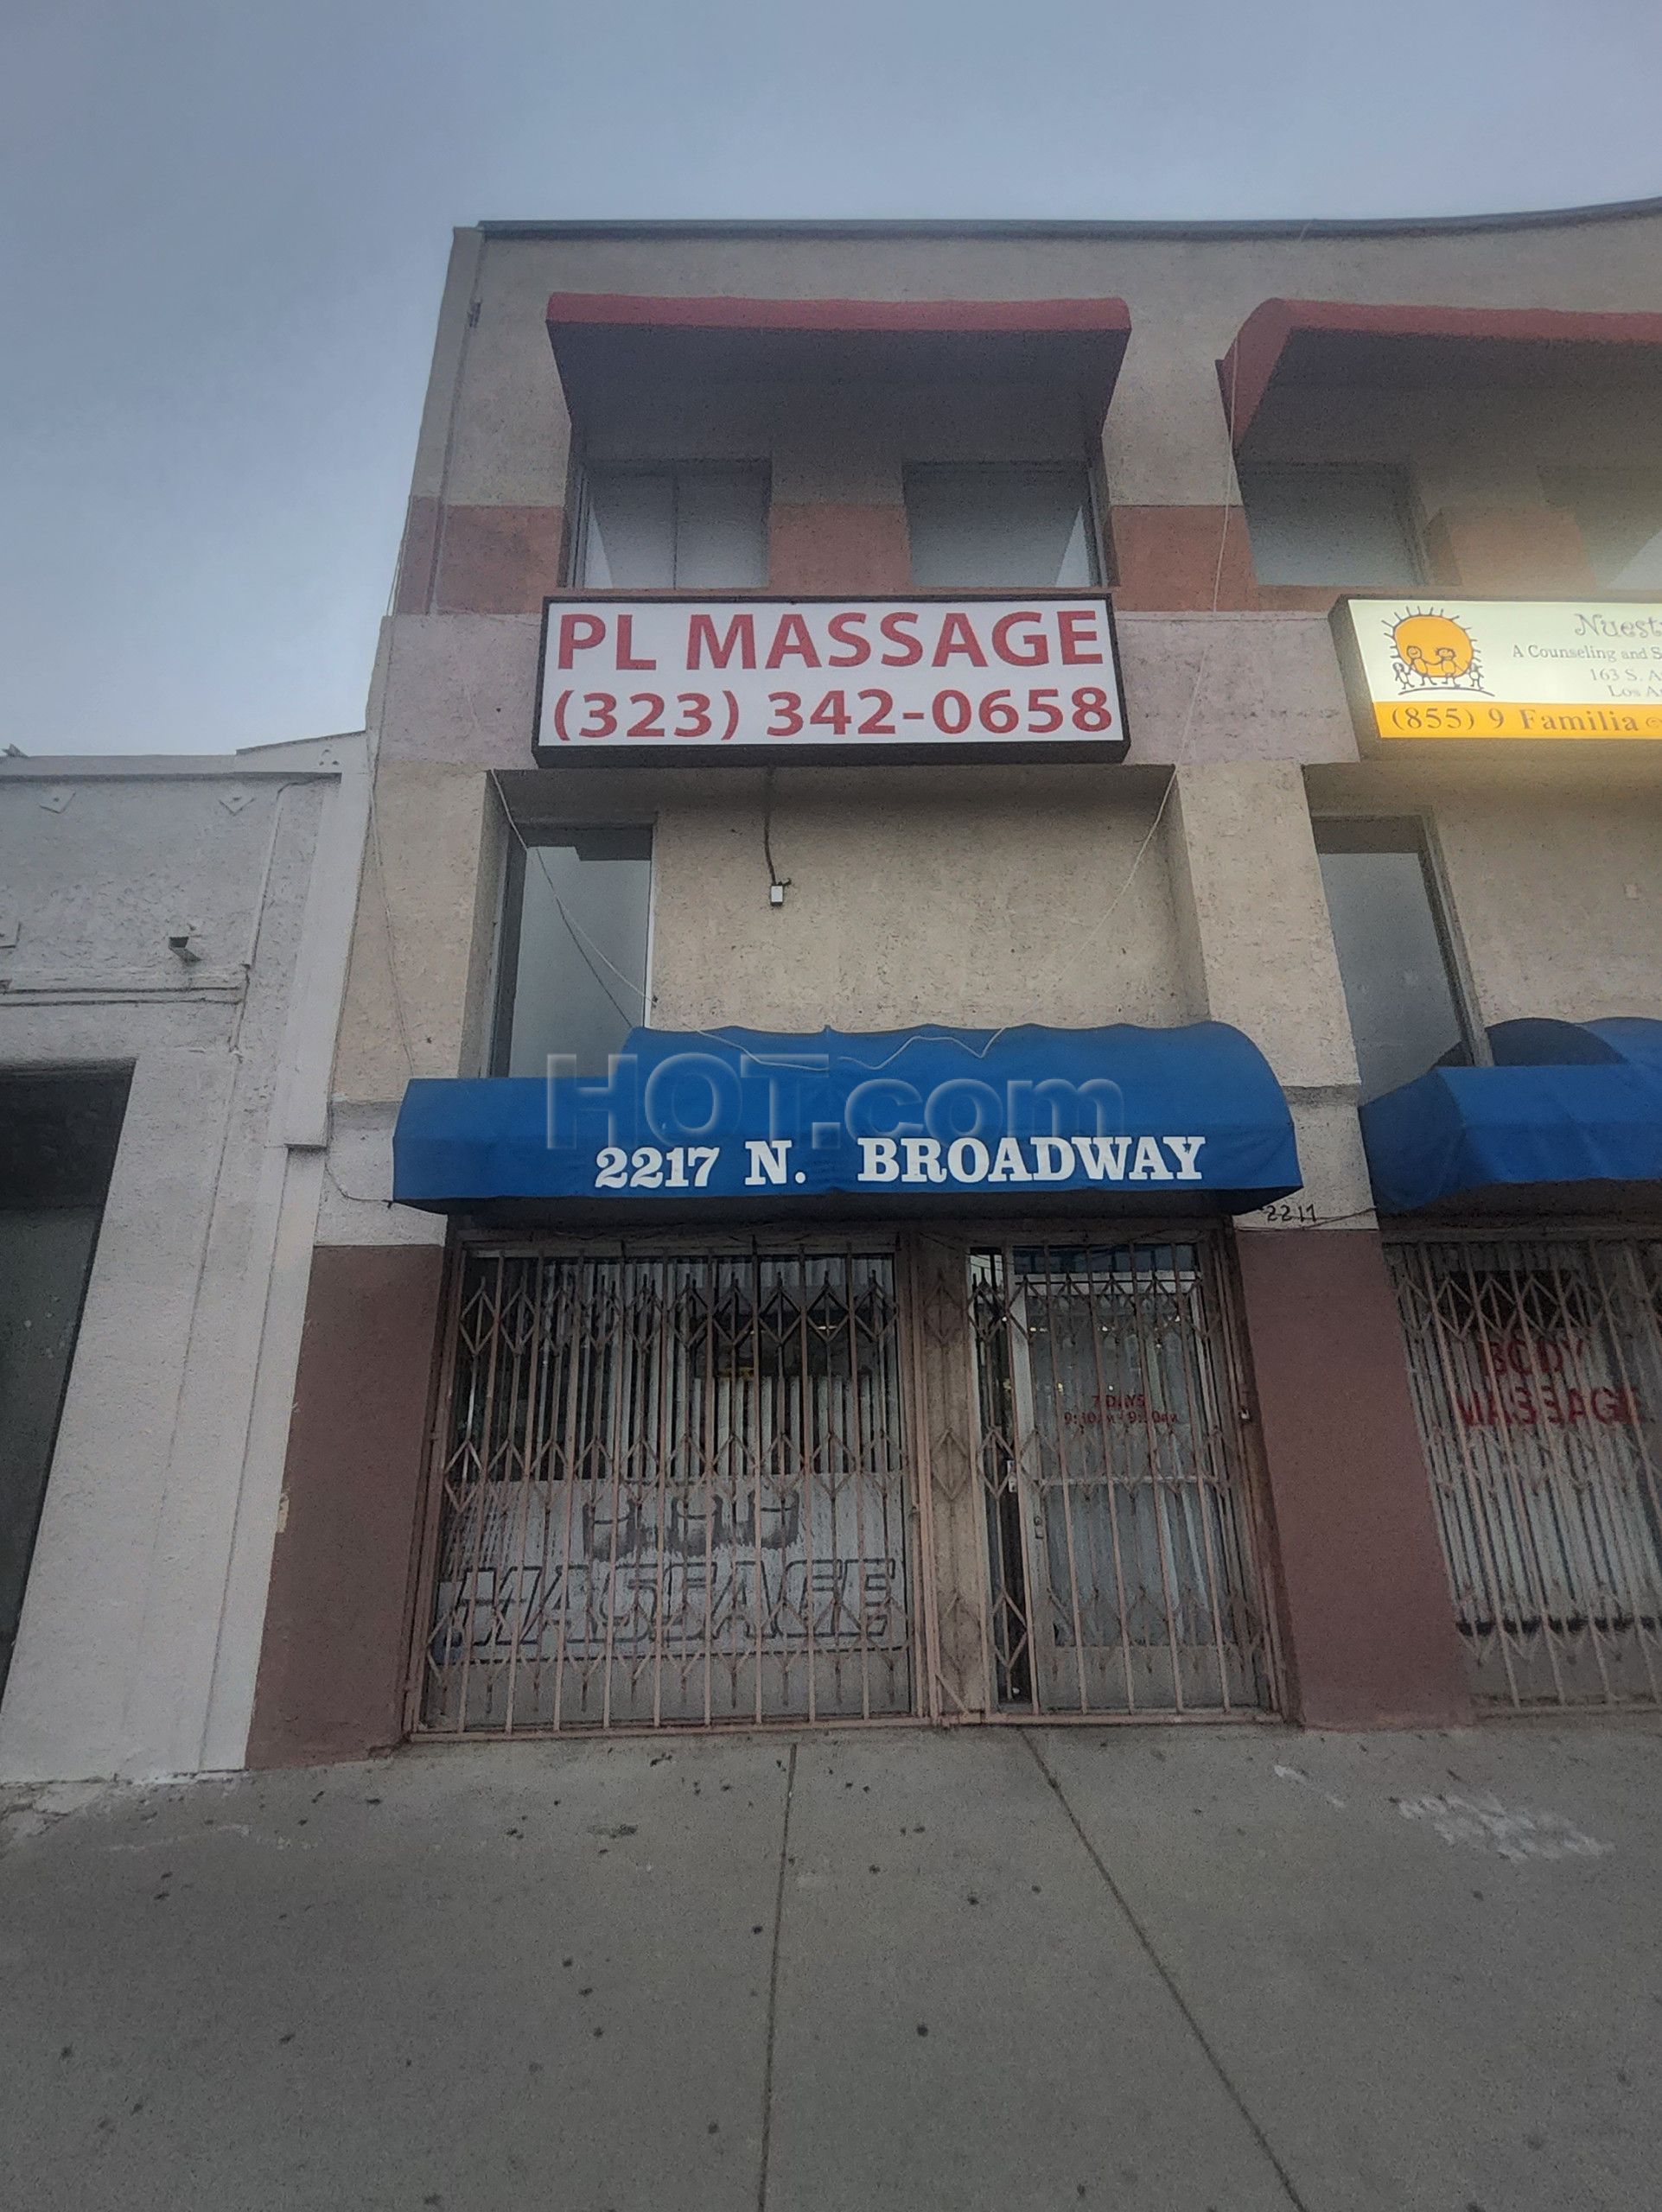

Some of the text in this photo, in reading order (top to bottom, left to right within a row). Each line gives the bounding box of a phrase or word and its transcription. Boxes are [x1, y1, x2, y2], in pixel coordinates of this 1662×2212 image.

[557, 610, 1105, 671] PL MASSAGE
[1512, 645, 1662, 663] A Counseling and S
[1589, 668, 1662, 682] 163 S. A
[1608, 684, 1662, 698] Los A
[554, 686, 1113, 742] (323) 342-0658
[1391, 707, 1640, 732] (855) 9 Familia
[595, 1136, 1207, 1189] 2217 N. BROADWAY
